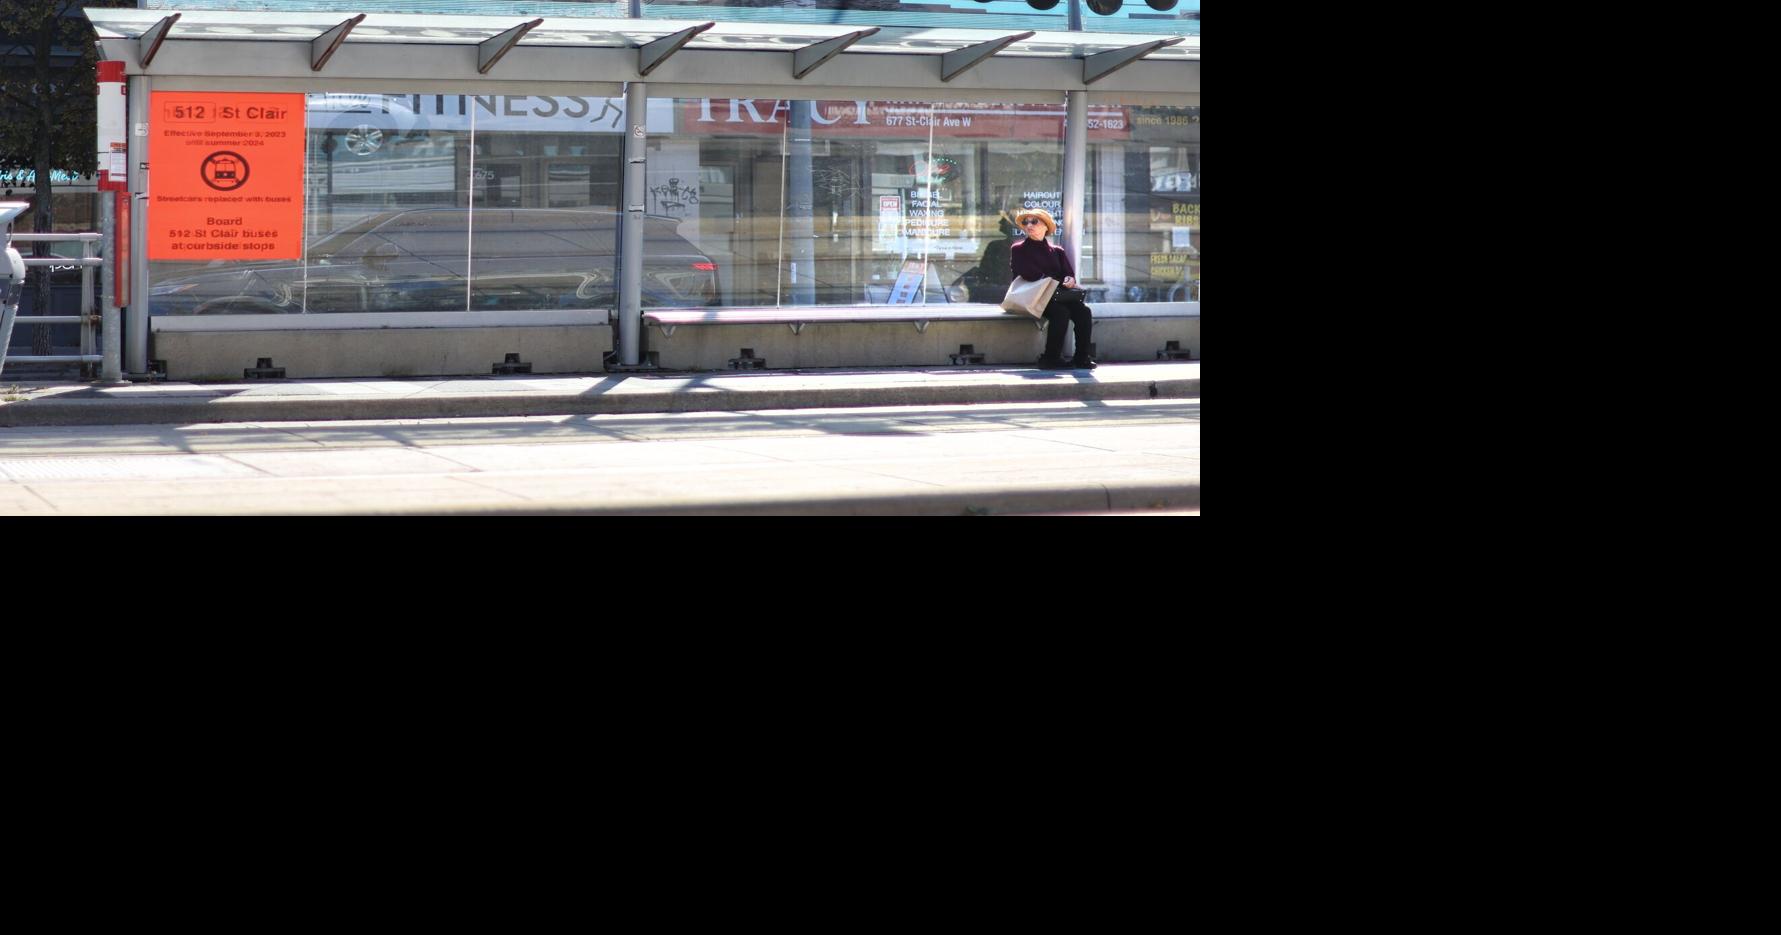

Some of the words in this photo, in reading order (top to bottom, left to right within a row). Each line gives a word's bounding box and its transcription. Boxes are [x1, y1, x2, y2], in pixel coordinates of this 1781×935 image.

[174, 105, 206, 119] 512
[222, 106, 240, 119] St
[246, 106, 288, 119] Clair
[886, 117, 903, 126] 677
[943, 117, 960, 127] Ave
[963, 117, 972, 127] W
[1087, 119, 1124, 129] 52-1623
[163, 129, 203, 137] Effective
[204, 130, 253, 139] September
[1023, 191, 1061, 200] HAIRCUT
[206, 216, 243, 226] Board
[169, 229, 192, 238] 512
[194, 228, 207, 238] St
[210, 228, 239, 239] Clair
[242, 229, 279, 238] buses
[171, 241, 183, 250] at
[186, 241, 239, 251] curbside
[242, 241, 276, 252] stops
